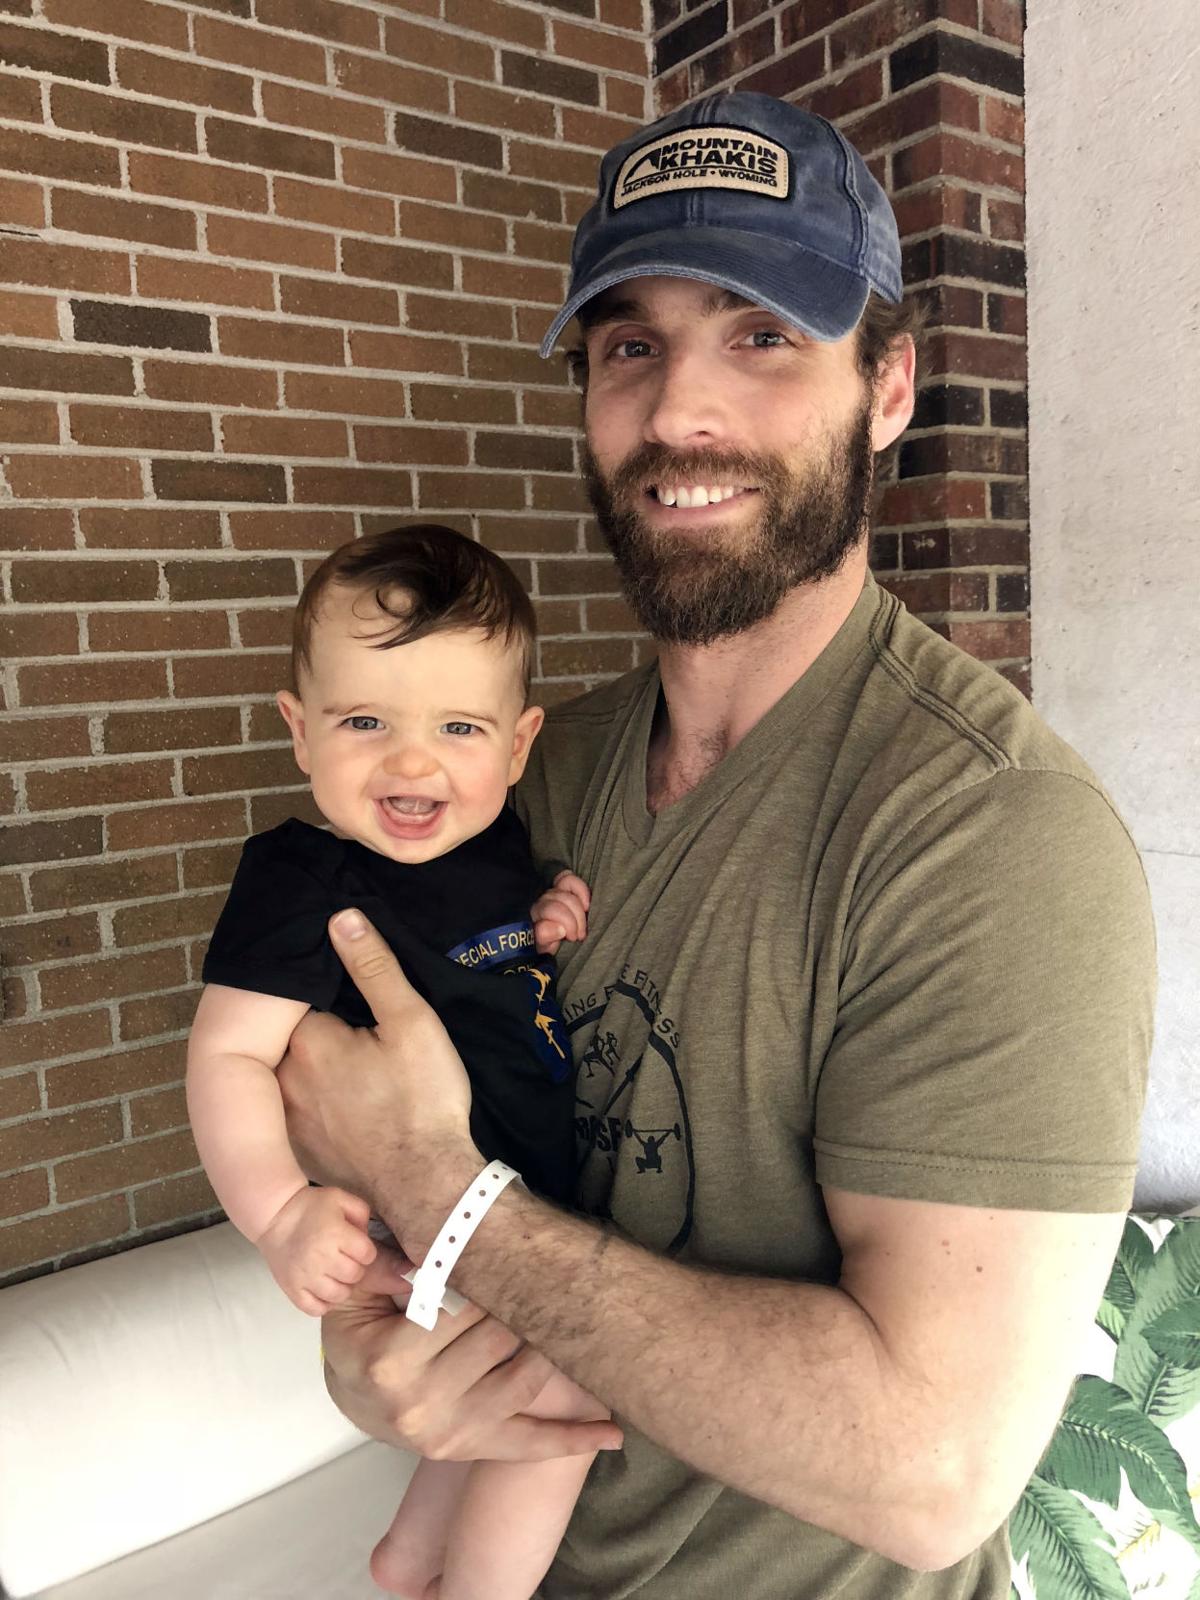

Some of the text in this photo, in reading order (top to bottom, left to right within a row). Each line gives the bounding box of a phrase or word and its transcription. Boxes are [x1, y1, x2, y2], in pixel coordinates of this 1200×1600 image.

[659, 150, 777, 174] KHAKIS
[662, 138, 778, 161] MOUNTAIN
[621, 168, 778, 196] JACKSON HOLE WYOMING
[453, 928, 535, 967] ECIAL FORC
[564, 993, 597, 1020] ING
